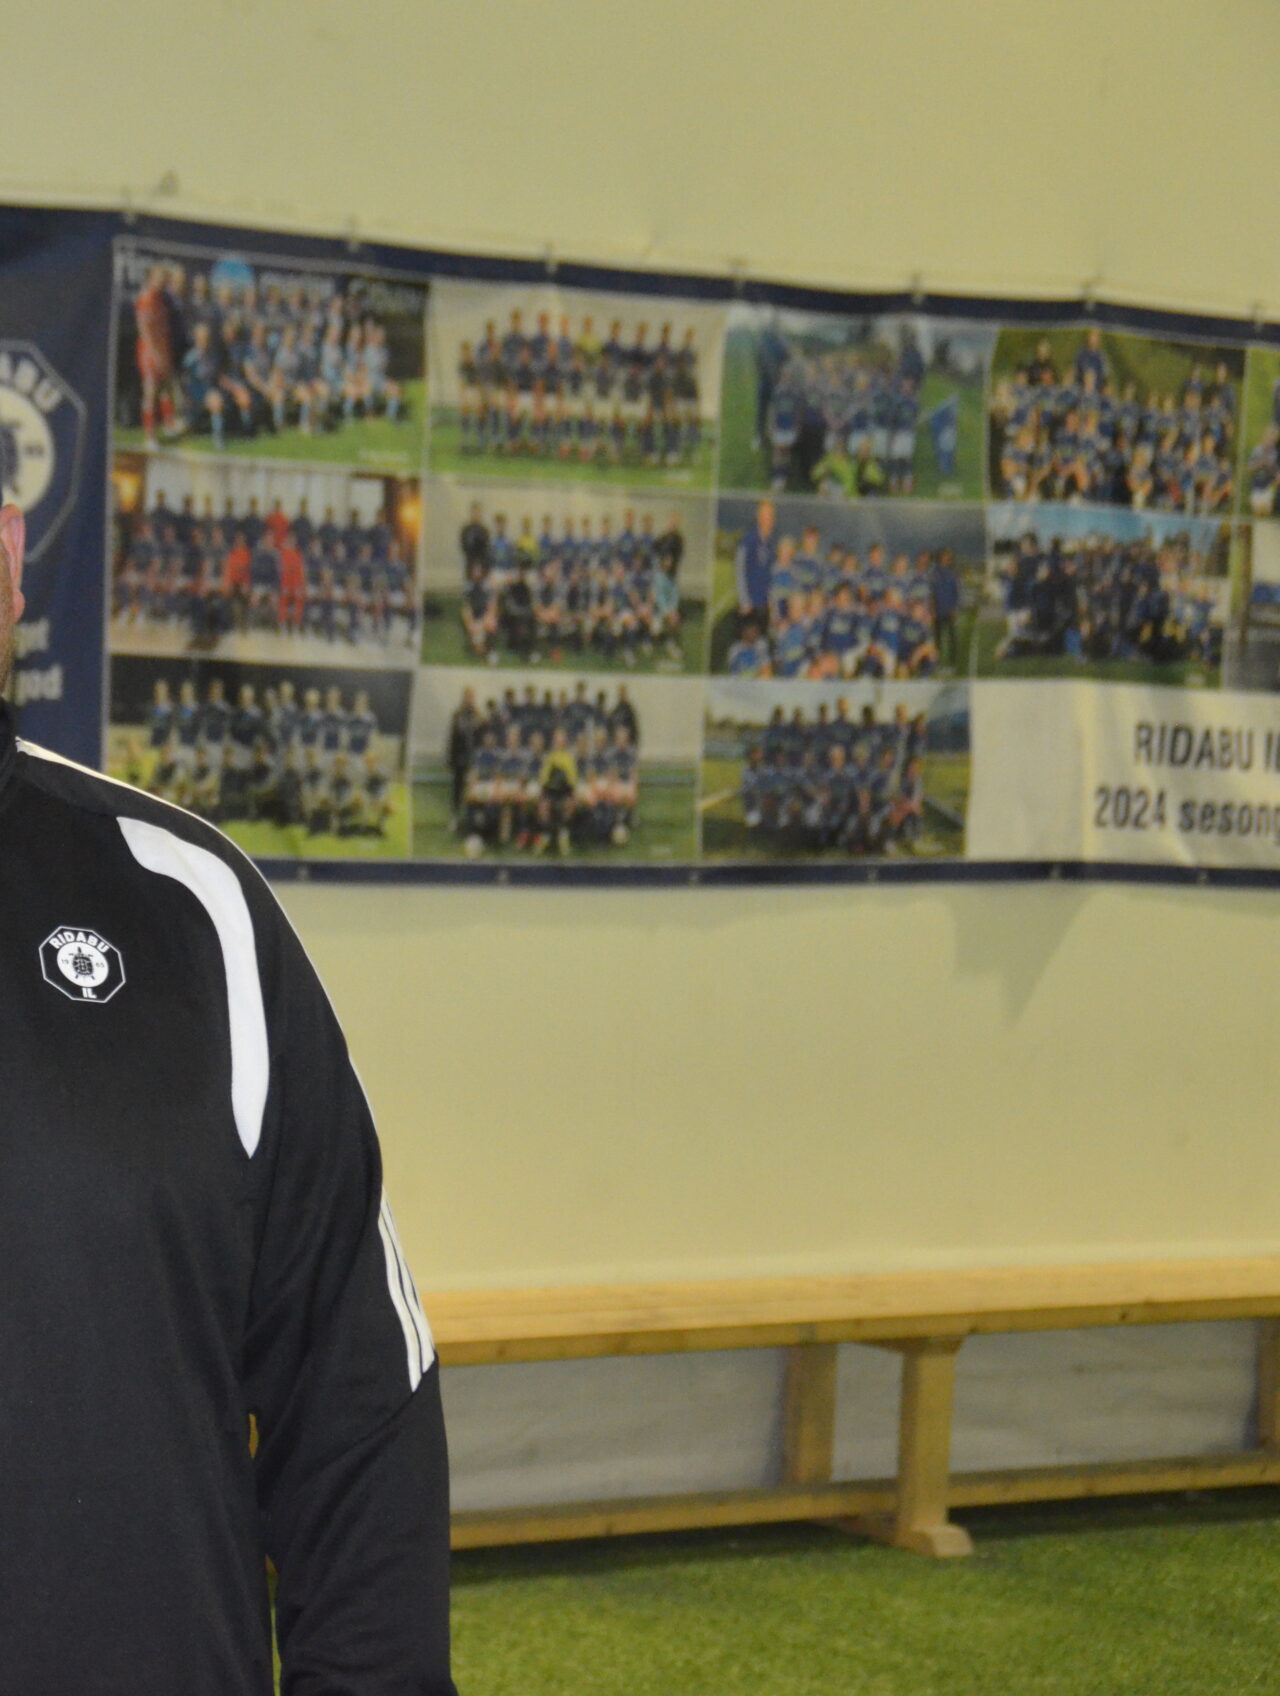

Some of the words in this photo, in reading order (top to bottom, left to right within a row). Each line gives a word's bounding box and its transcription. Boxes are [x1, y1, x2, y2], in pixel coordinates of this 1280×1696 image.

[1134, 721, 1254, 772] RIDABU
[1094, 783, 1167, 830] 2024
[48, 931, 109, 953] RIDABU
[81, 987, 97, 999] IL
